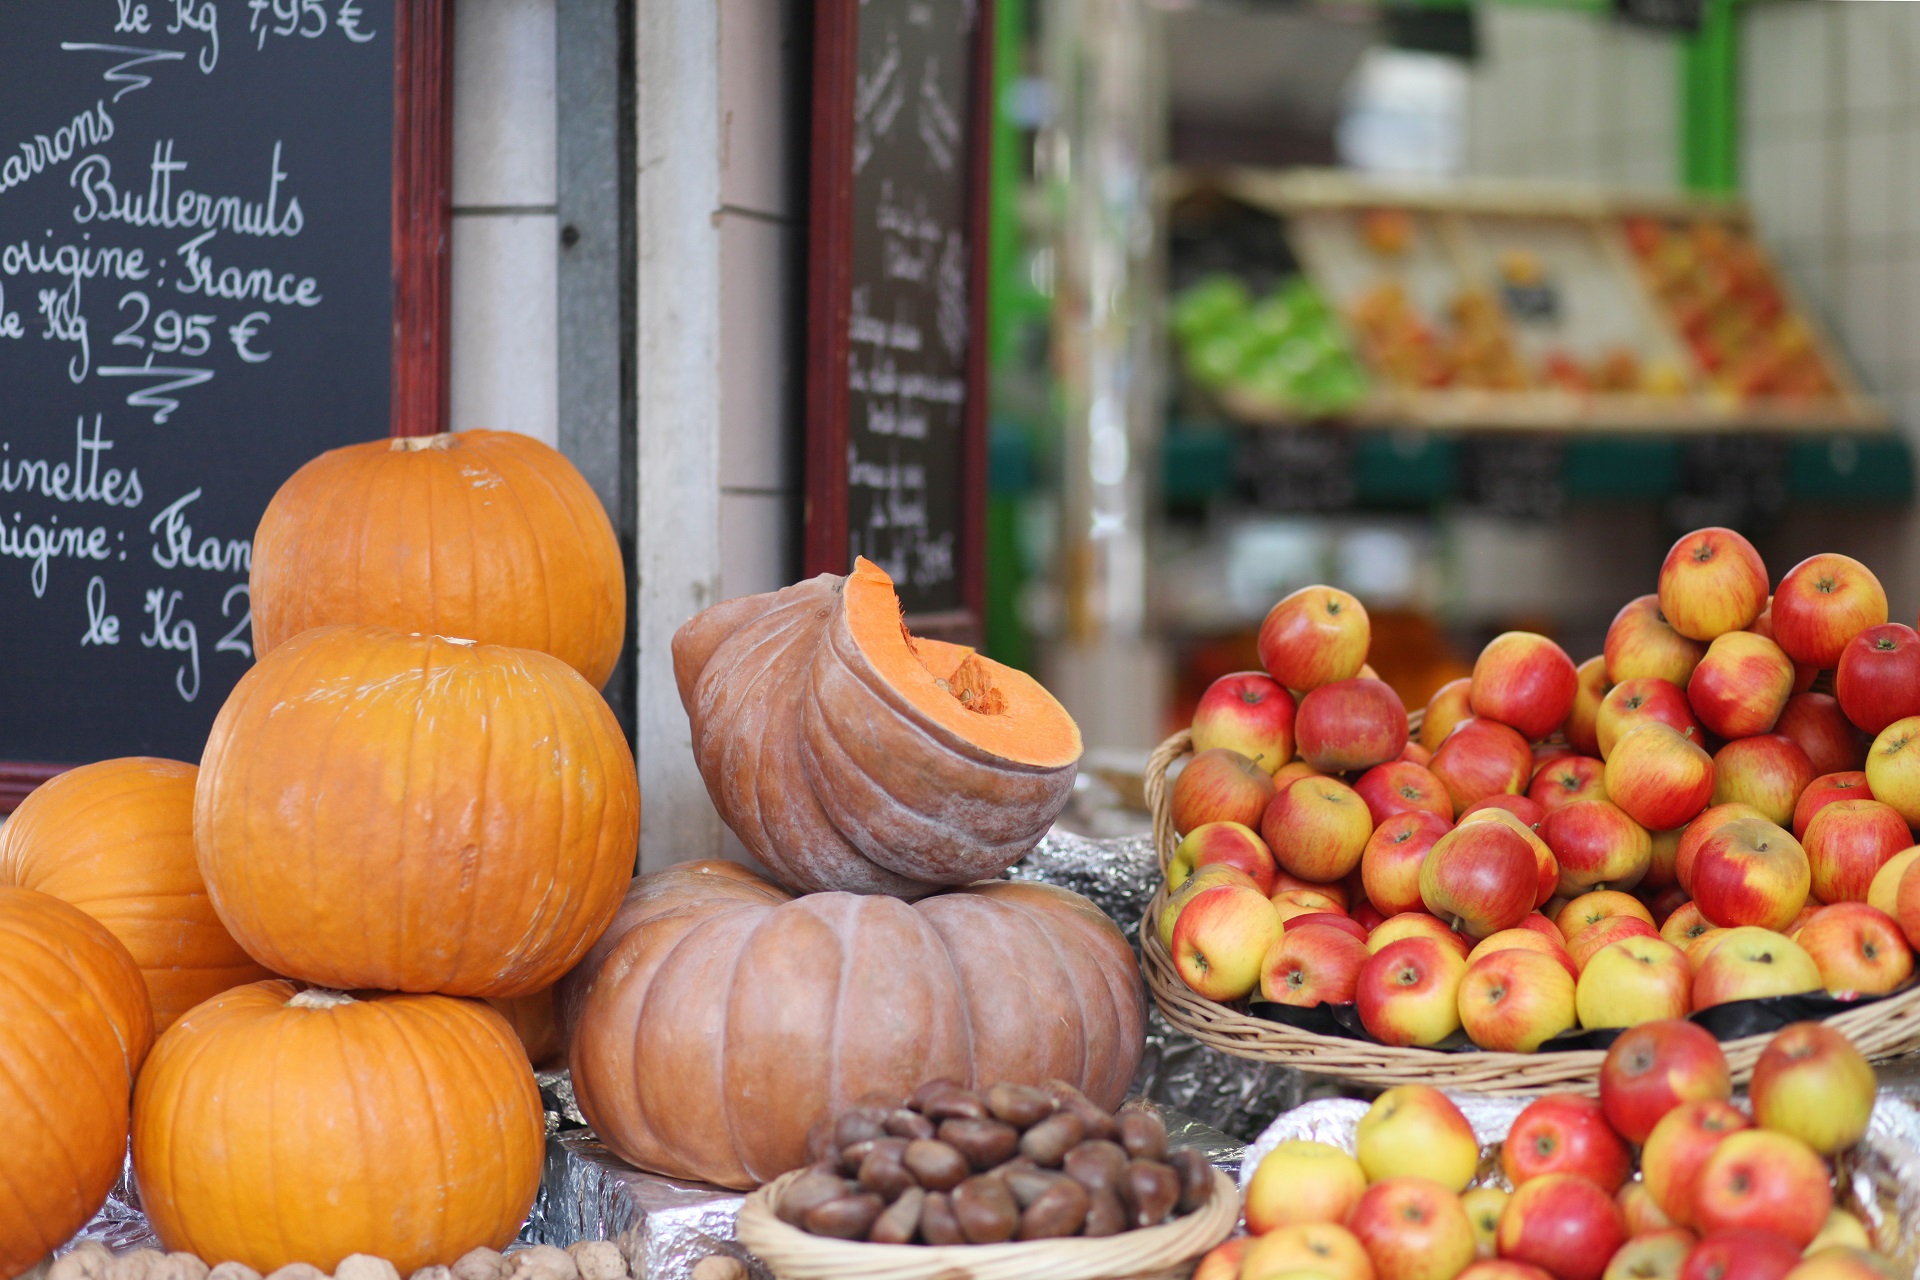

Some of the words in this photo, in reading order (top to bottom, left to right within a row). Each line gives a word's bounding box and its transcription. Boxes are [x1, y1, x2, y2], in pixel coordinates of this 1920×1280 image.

[113, 0, 152, 34] le
[166, 0, 219, 75] Kg
[336, 0, 376, 43] €
[0, 99, 115, 194] arrons
[70, 139, 304, 237] Butternuts
[177, 229, 321, 307] France
[38, 289, 90, 383] Kg
[112, 291, 216, 370] 2,95
[229, 312, 271, 363] €
[0, 413, 143, 508] inettes
[81, 576, 120, 646] le
[140, 587, 200, 702] Kg
